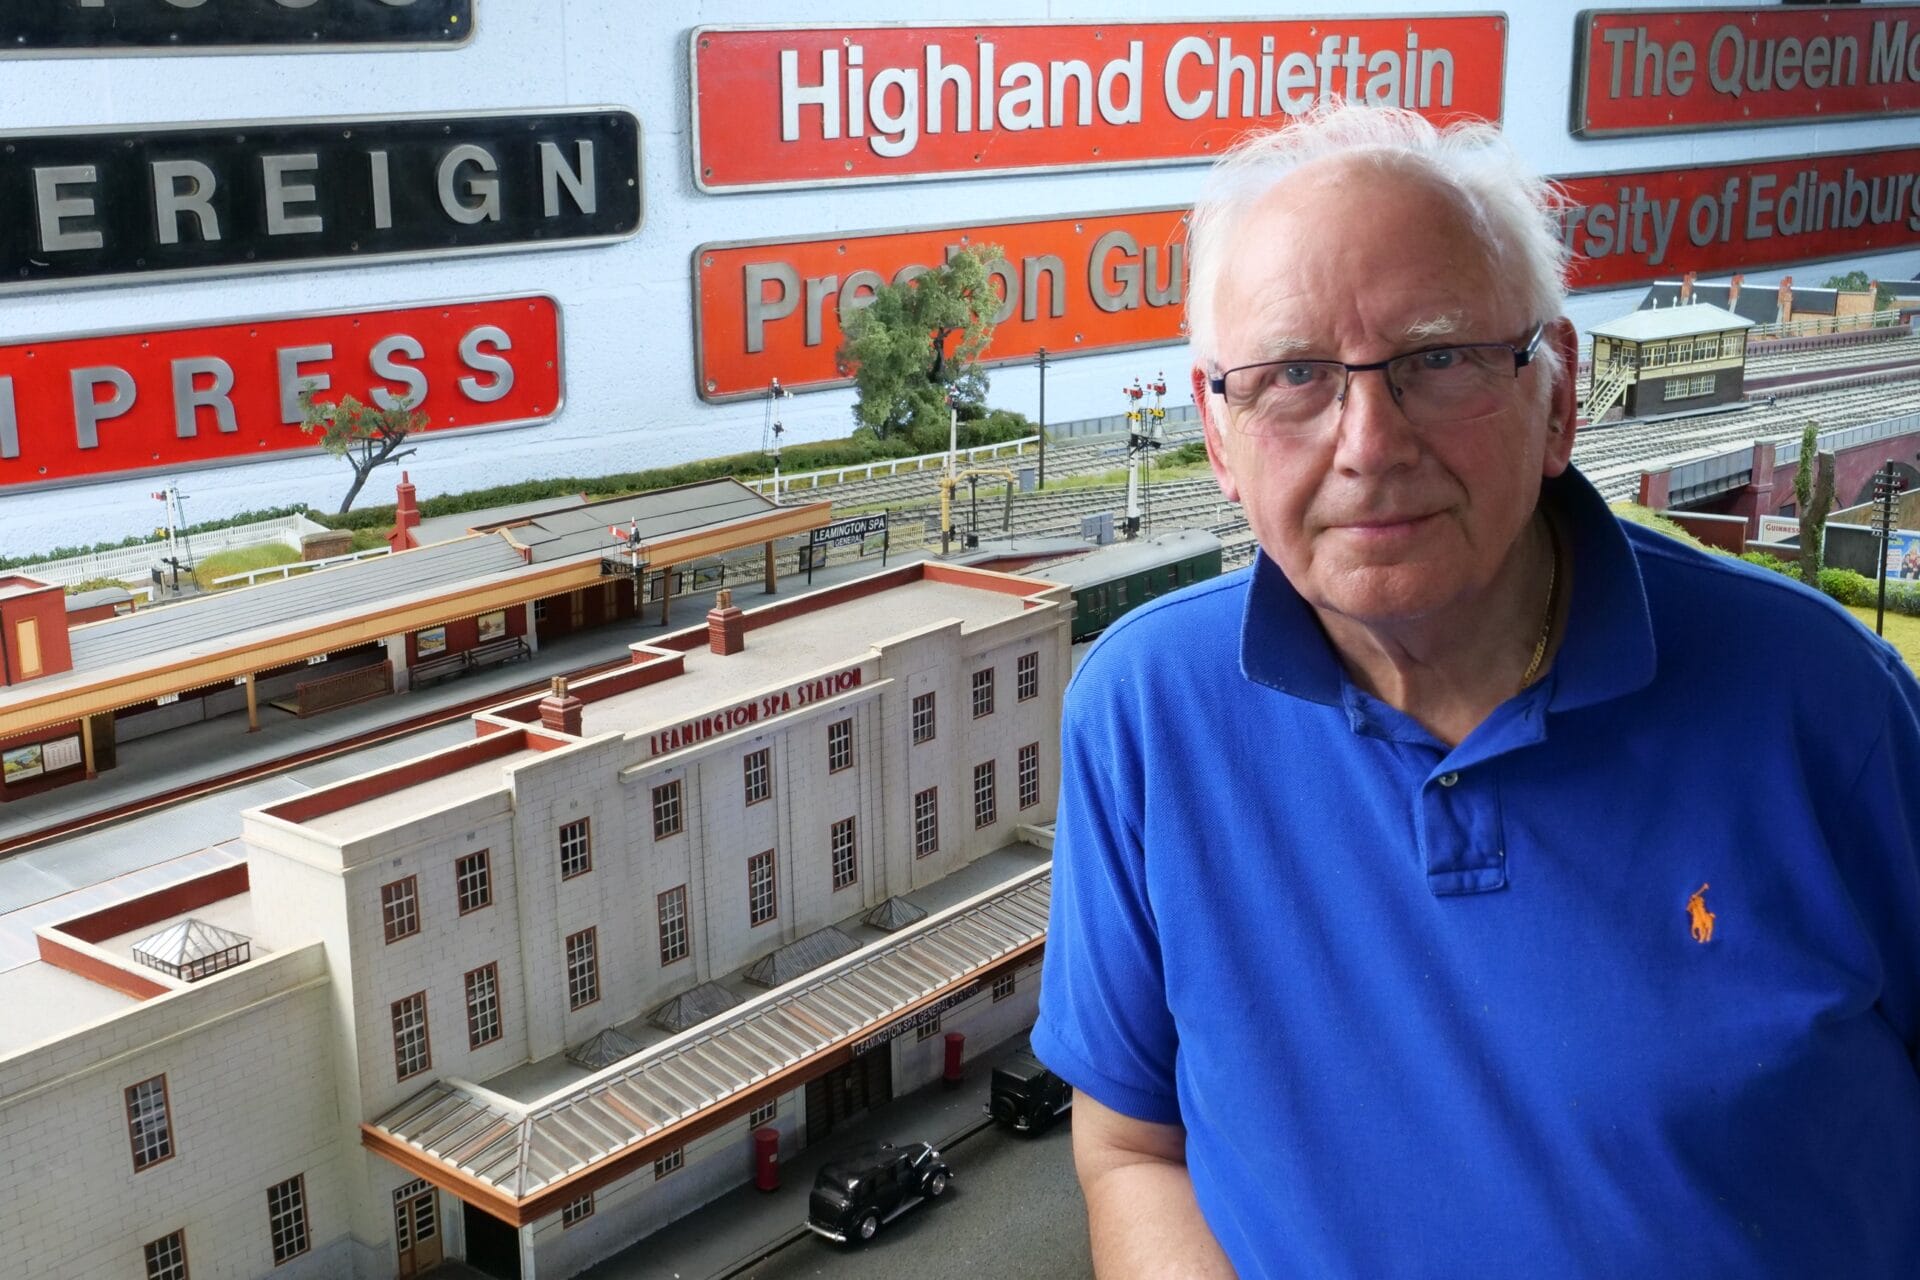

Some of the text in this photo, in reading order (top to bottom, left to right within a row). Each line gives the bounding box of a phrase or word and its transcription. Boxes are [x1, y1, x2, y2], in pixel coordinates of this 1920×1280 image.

[780, 33, 1454, 158] Highland Chieftain
[1603, 28, 1695, 98] The
[1709, 25, 1858, 98] Queen
[34, 140, 596, 252] EREIGN
[1689, 177, 1739, 247] of
[0, 325, 514, 457] PRESS
[814, 518, 885, 542] LEAMINGTON SPA
[834, 533, 863, 547] GENERAL
[651, 667, 862, 756] LEAMINGTON SPA STATION
